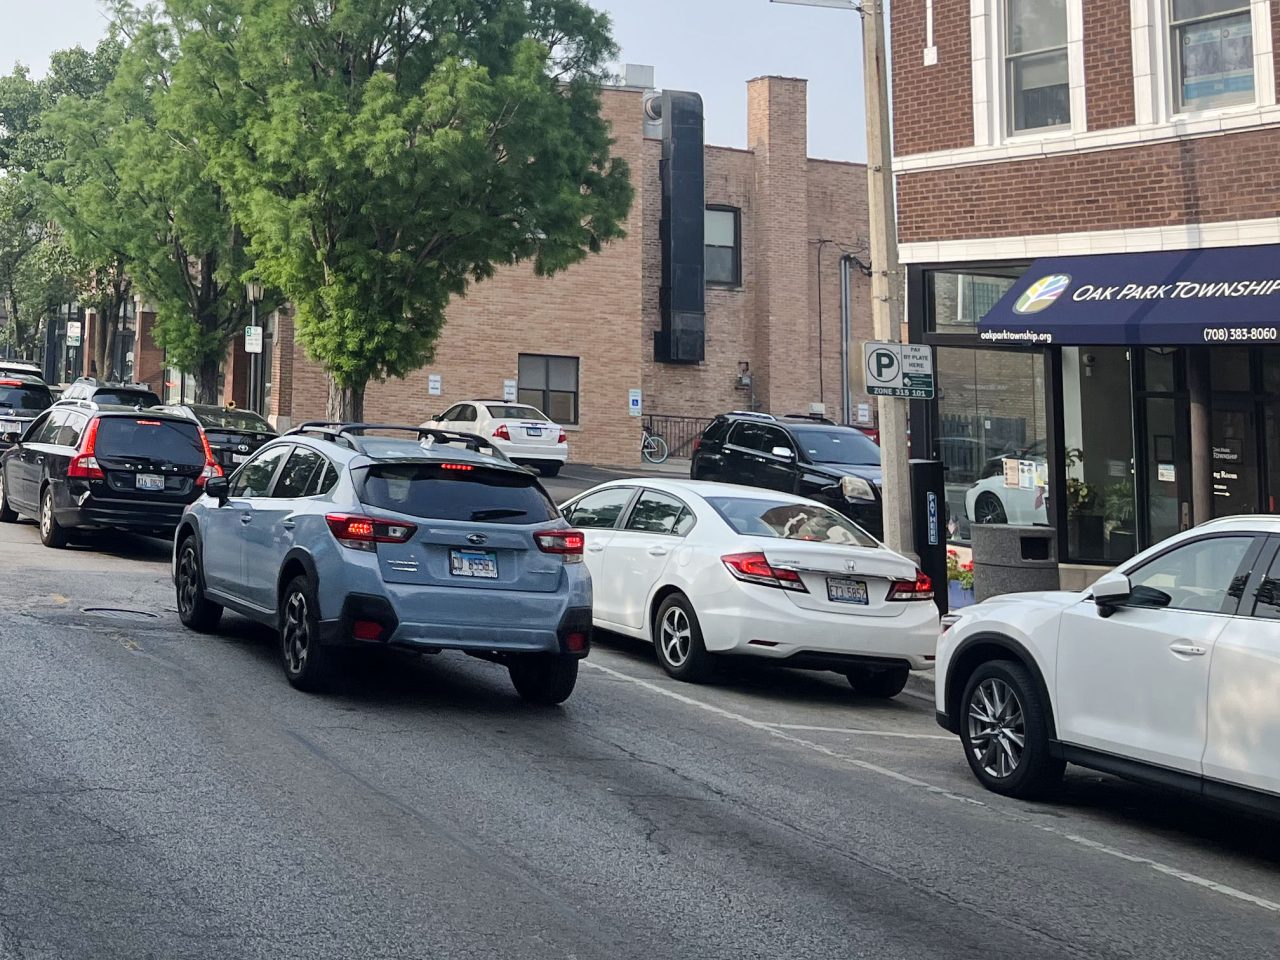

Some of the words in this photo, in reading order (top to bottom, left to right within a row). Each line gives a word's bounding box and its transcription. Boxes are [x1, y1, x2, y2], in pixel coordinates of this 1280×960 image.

[1072, 285, 1120, 301] OAK
[1117, 283, 1173, 300] PARK
[1170, 280, 1280, 299] TOWNSHIP
[980, 330, 1052, 343] oakparktownship.org
[1203, 328, 1228, 341] (708)
[1229, 327, 1277, 340] 383-8060
[875, 352, 895, 378] P
[873, 387, 893, 395] ZONE
